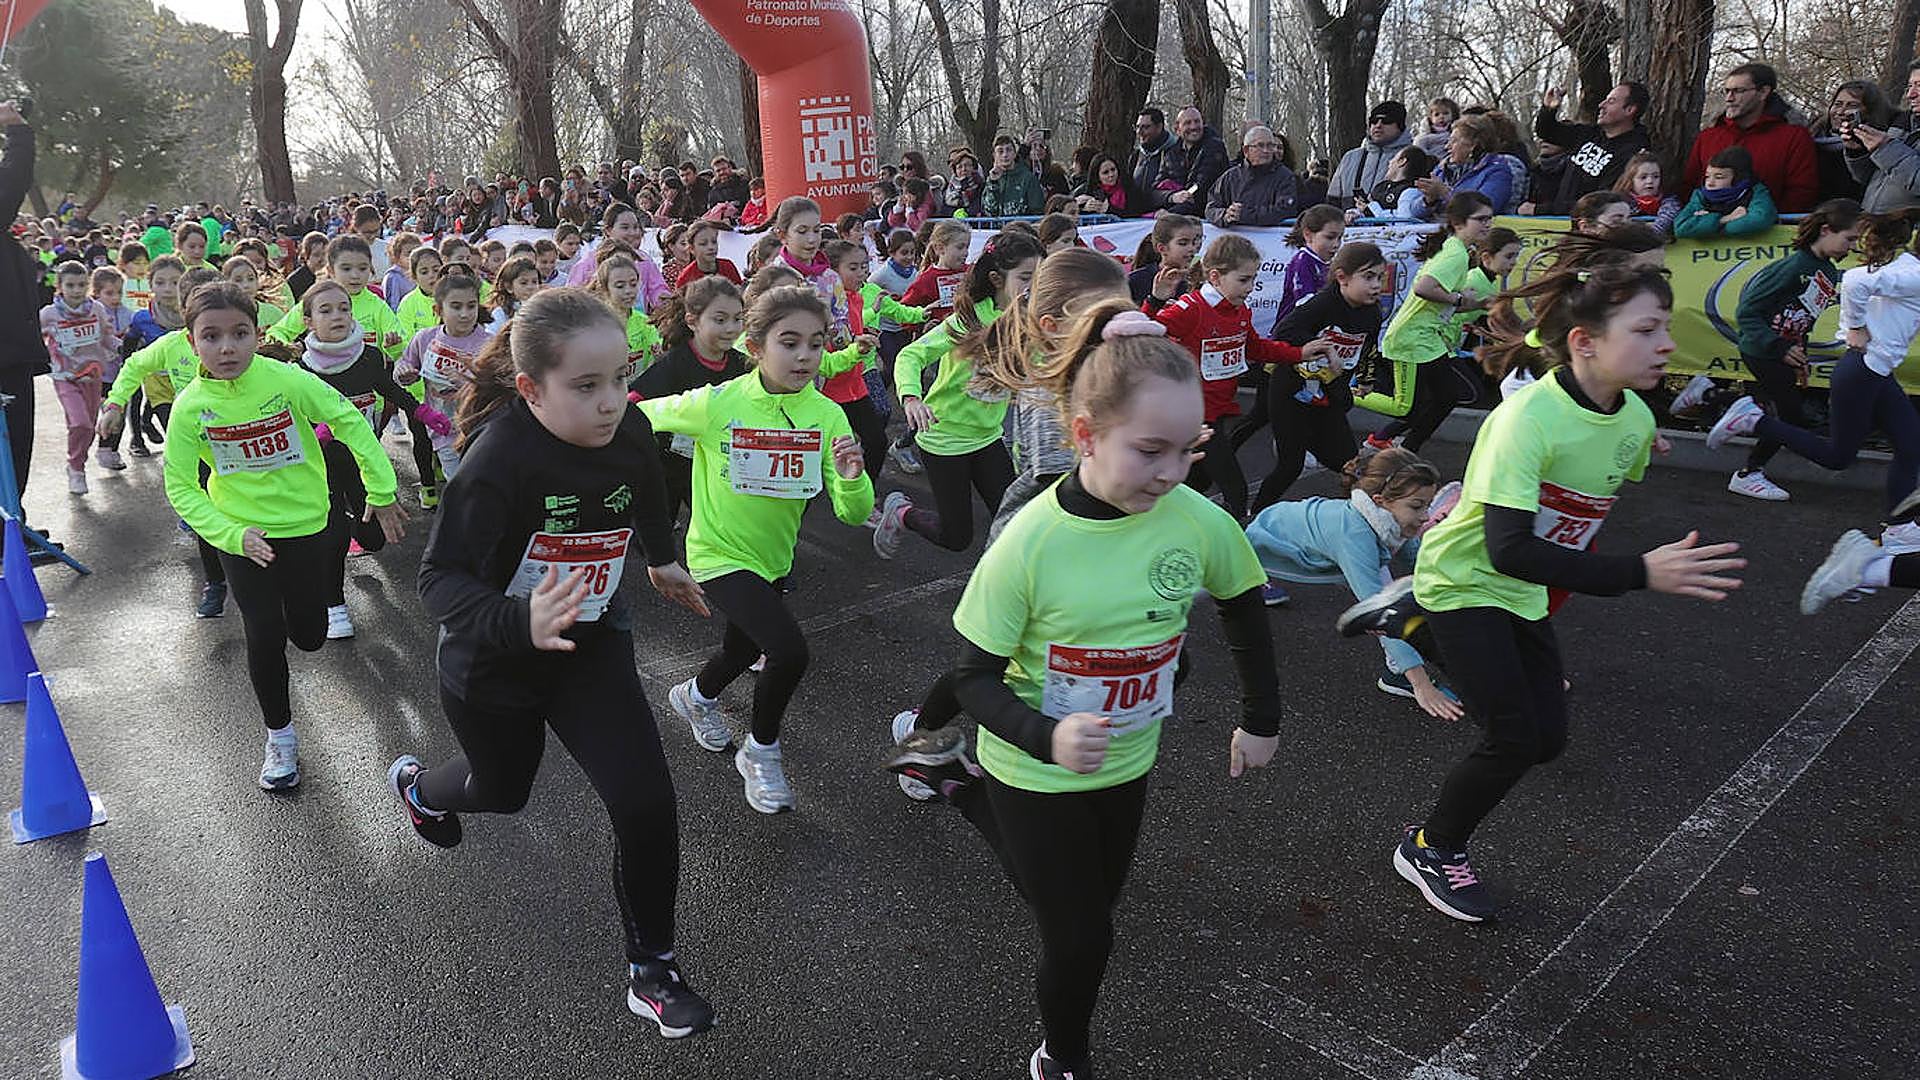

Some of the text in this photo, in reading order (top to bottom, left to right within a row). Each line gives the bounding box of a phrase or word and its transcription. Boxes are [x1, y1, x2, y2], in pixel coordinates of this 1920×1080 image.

[747, 0, 807, 11] Patronato
[746, 13, 820, 28] de Deportes
[1571, 150, 1602, 177] JONES
[1692, 244, 1790, 263] PUENT
[238, 431, 290, 459] 1138
[768, 453, 804, 479] 715
[1544, 515, 1593, 545] 752
[1101, 672, 1160, 713] 704
